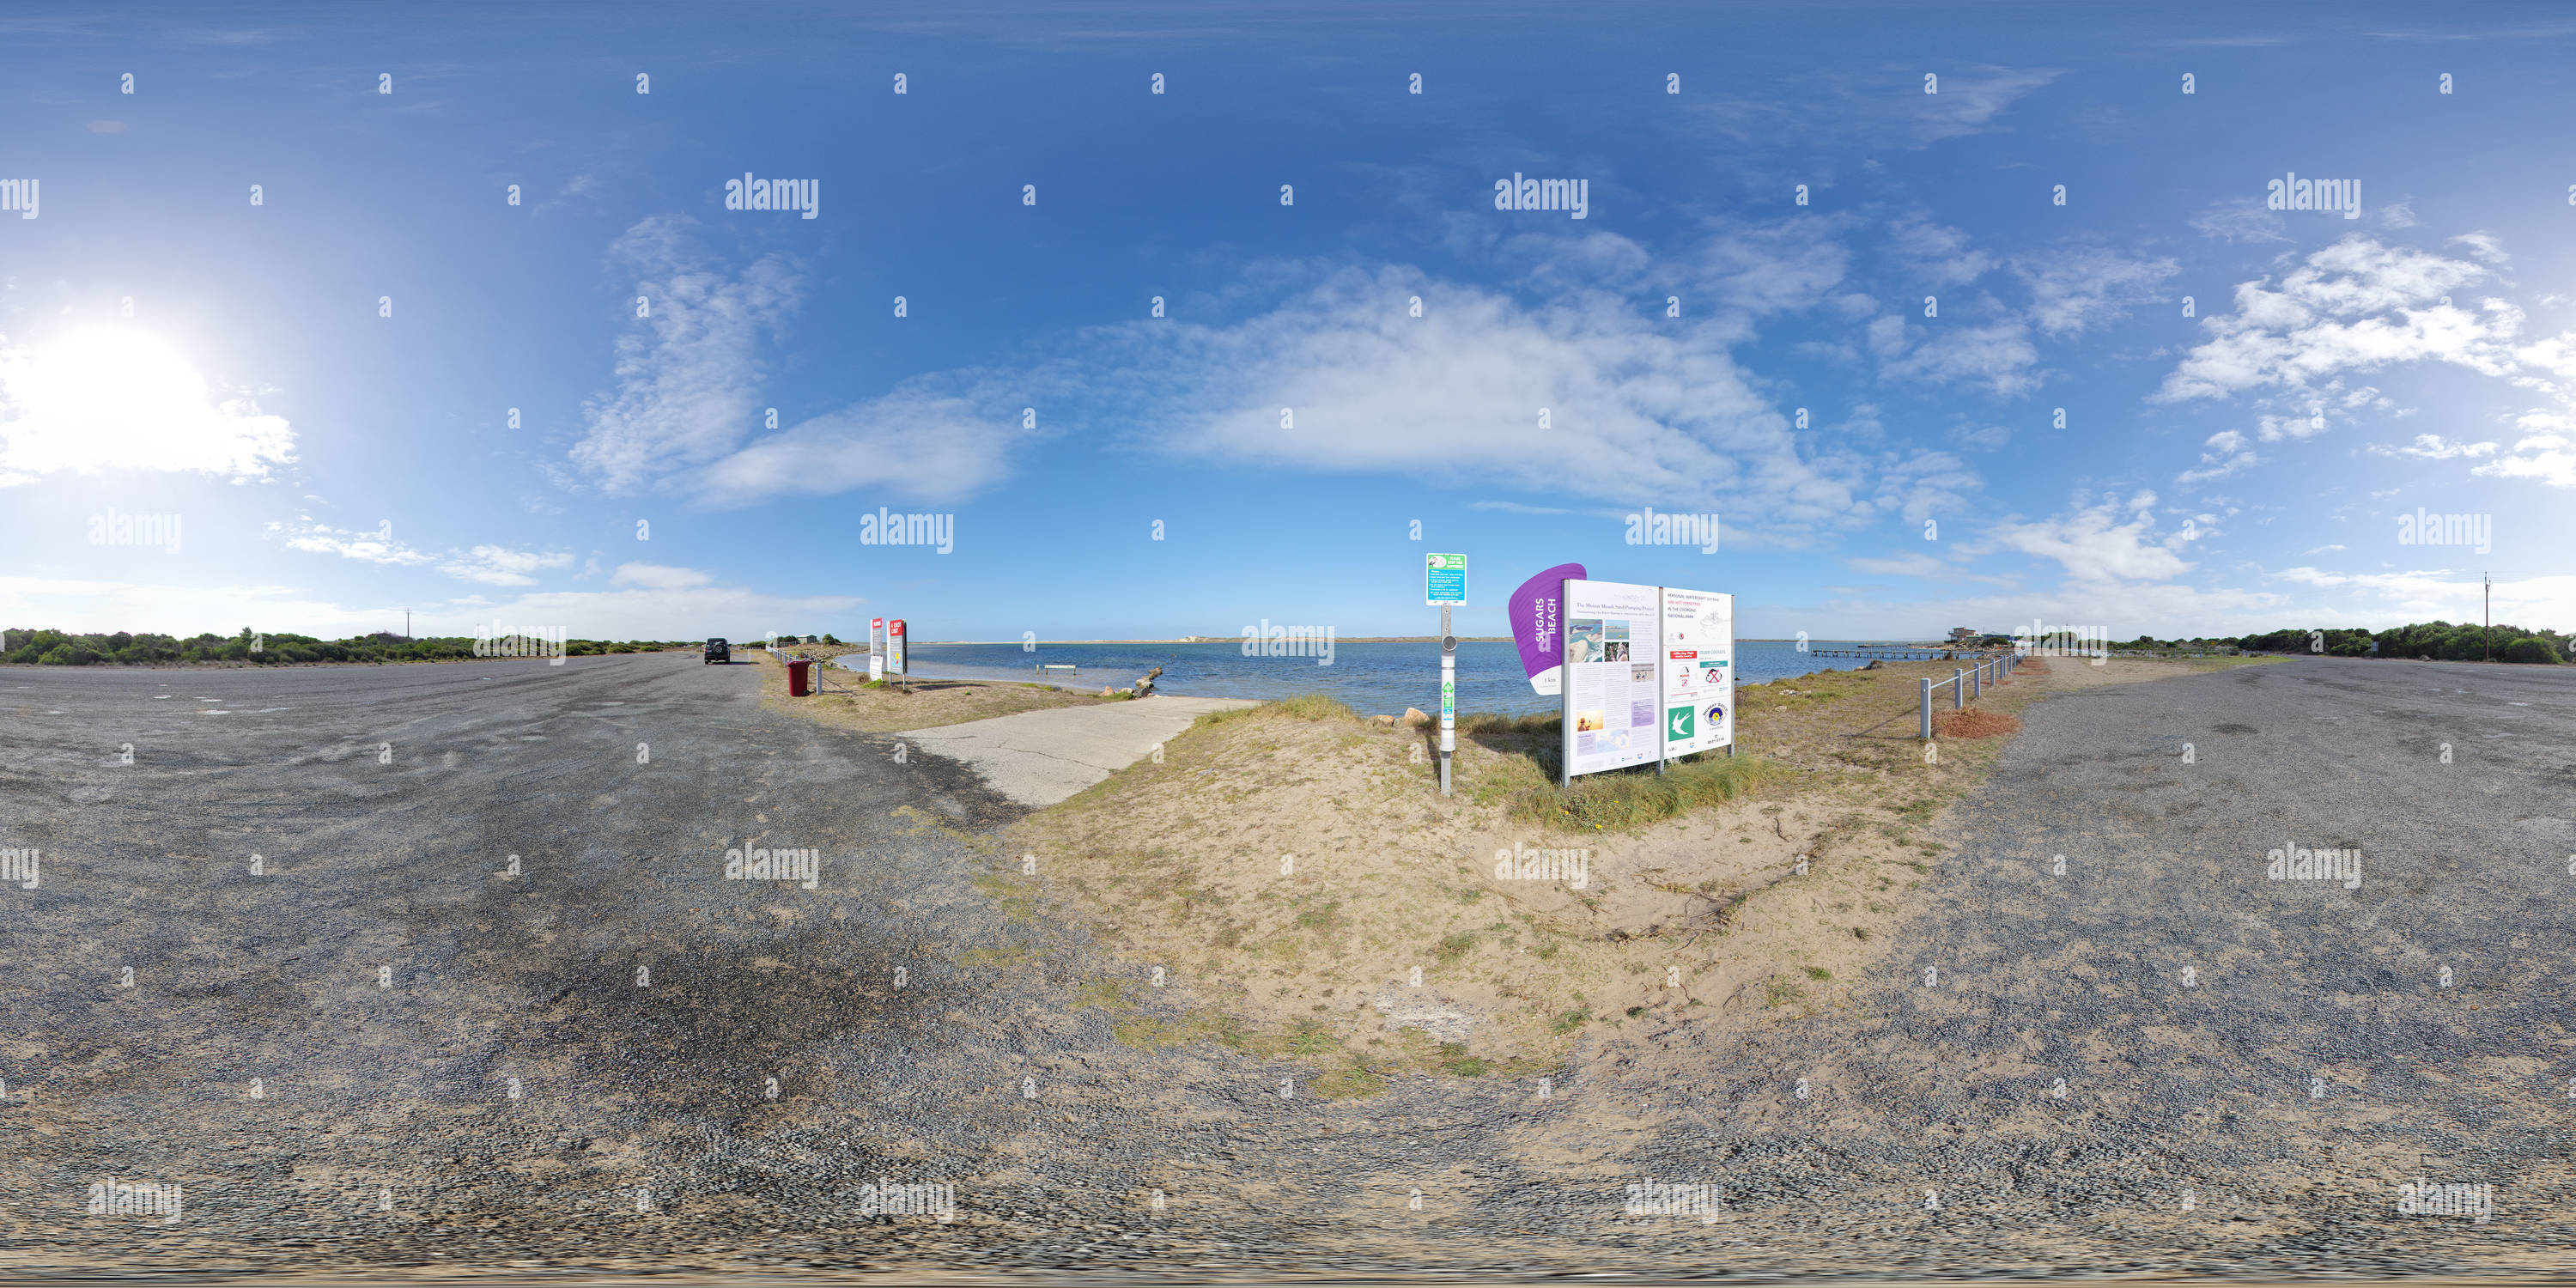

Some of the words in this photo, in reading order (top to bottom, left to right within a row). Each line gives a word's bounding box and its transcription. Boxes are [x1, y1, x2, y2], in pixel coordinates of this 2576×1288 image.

[1535, 598, 1544, 642] SUGARS
[1704, 703, 1716, 715] MURRAY
[1717, 703, 1728, 712] WATCH
